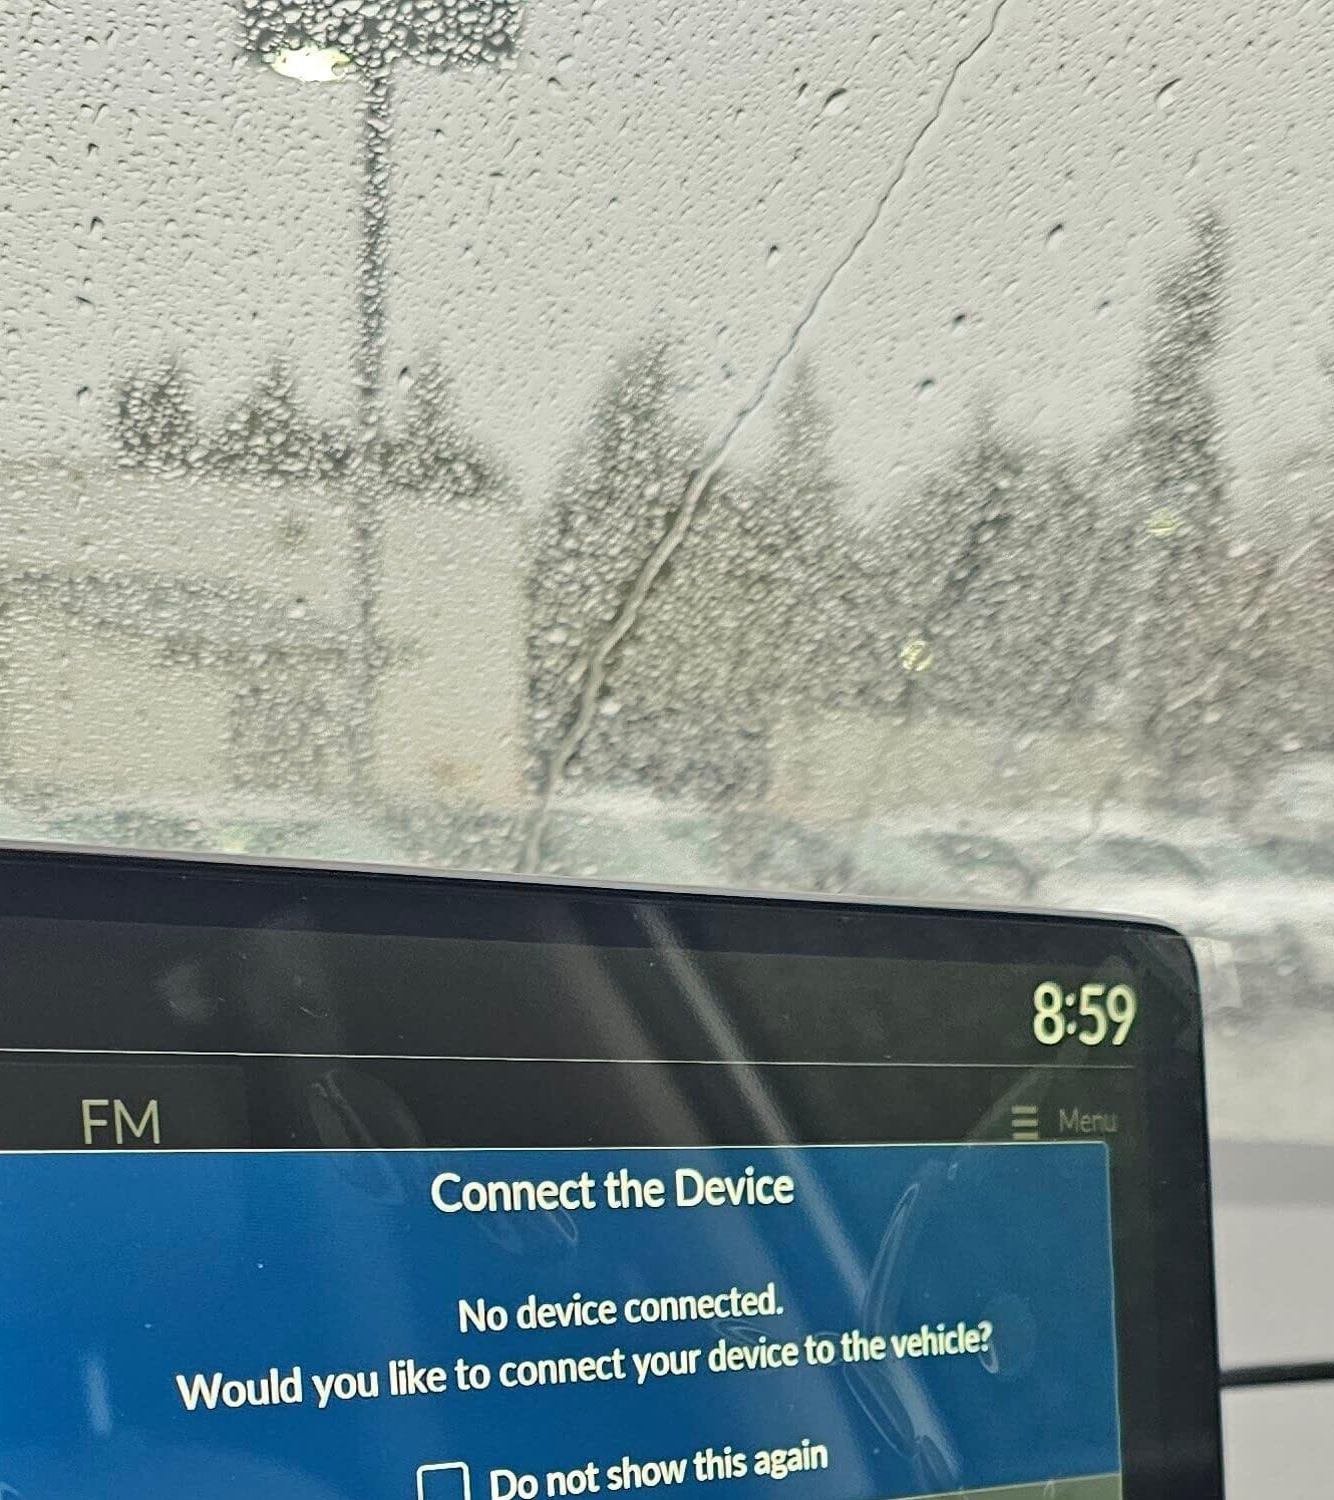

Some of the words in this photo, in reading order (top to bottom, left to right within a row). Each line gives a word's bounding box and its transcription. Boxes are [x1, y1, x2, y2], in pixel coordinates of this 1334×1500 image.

[1032, 981, 1136, 1046] 8:59
[81, 1099, 161, 1144] FM
[1058, 1108, 1118, 1134] Menu
[431, 1172, 596, 1213] Connect
[604, 1170, 665, 1208] the
[674, 1167, 795, 1207] Device
[457, 1299, 509, 1333] No
[516, 1293, 617, 1330] device
[623, 1284, 784, 1325] connected.
[175, 1365, 304, 1411] Would
[312, 1371, 380, 1410] you
[389, 1358, 448, 1395] like
[455, 1360, 492, 1391] to
[498, 1352, 626, 1389] connect
[632, 1345, 701, 1386] your
[707, 1332, 800, 1373] device
[804, 1337, 836, 1364] to
[841, 1331, 887, 1363] the
[891, 1320, 994, 1358] vehicle?
[546, 1463, 601, 1496] not
[606, 1453, 688, 1492] show
[693, 1445, 749, 1481] this
[754, 1438, 829, 1477] again
